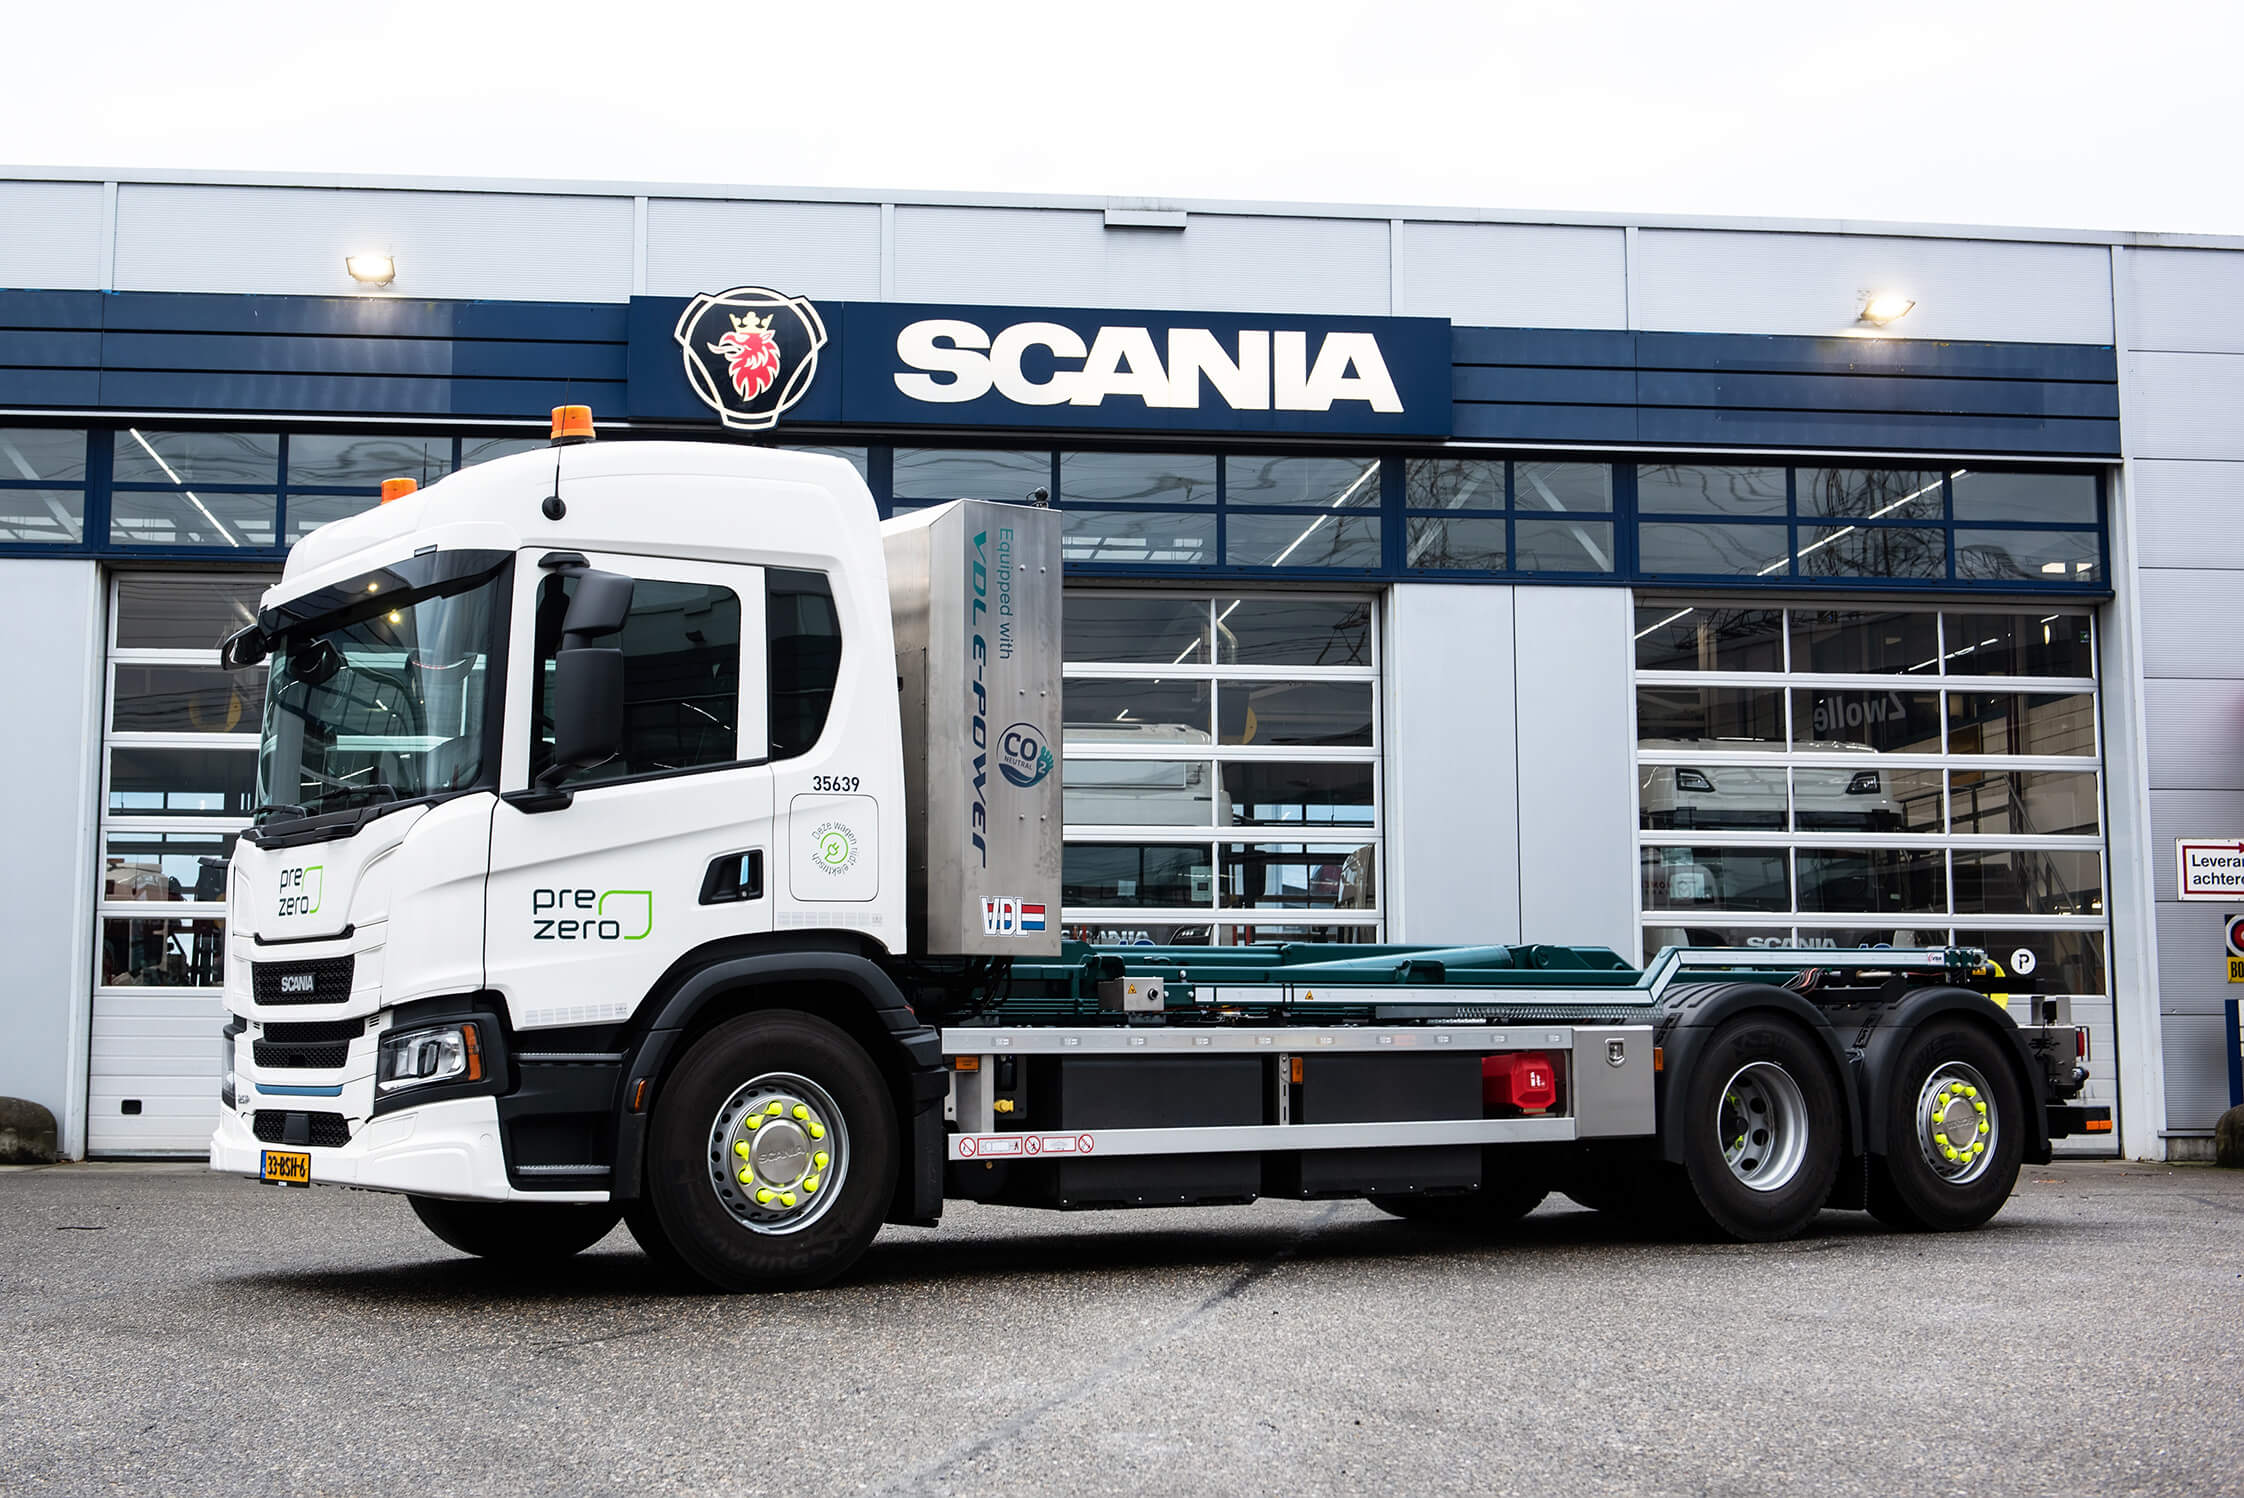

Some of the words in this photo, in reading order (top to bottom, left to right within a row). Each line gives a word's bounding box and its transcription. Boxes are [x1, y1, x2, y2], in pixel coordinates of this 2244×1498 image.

[893, 319, 1404, 413] SCANIA
[972, 530, 987, 627] VDL
[996, 528, 1014, 616] Equipped
[999, 622, 1014, 660] with
[1004, 755, 1033, 771] NEUTRAL
[812, 775, 860, 793] 35639
[811, 822, 832, 840] Deze
[833, 821, 857, 844] wagen
[280, 867, 303, 894] pre
[278, 895, 309, 917] zero
[533, 889, 596, 915] pre
[981, 897, 1028, 936] VDL
[533, 920, 620, 939] zero
[281, 975, 315, 992] SCANIA
[267, 1155, 306, 1178] 33-BSH-6
